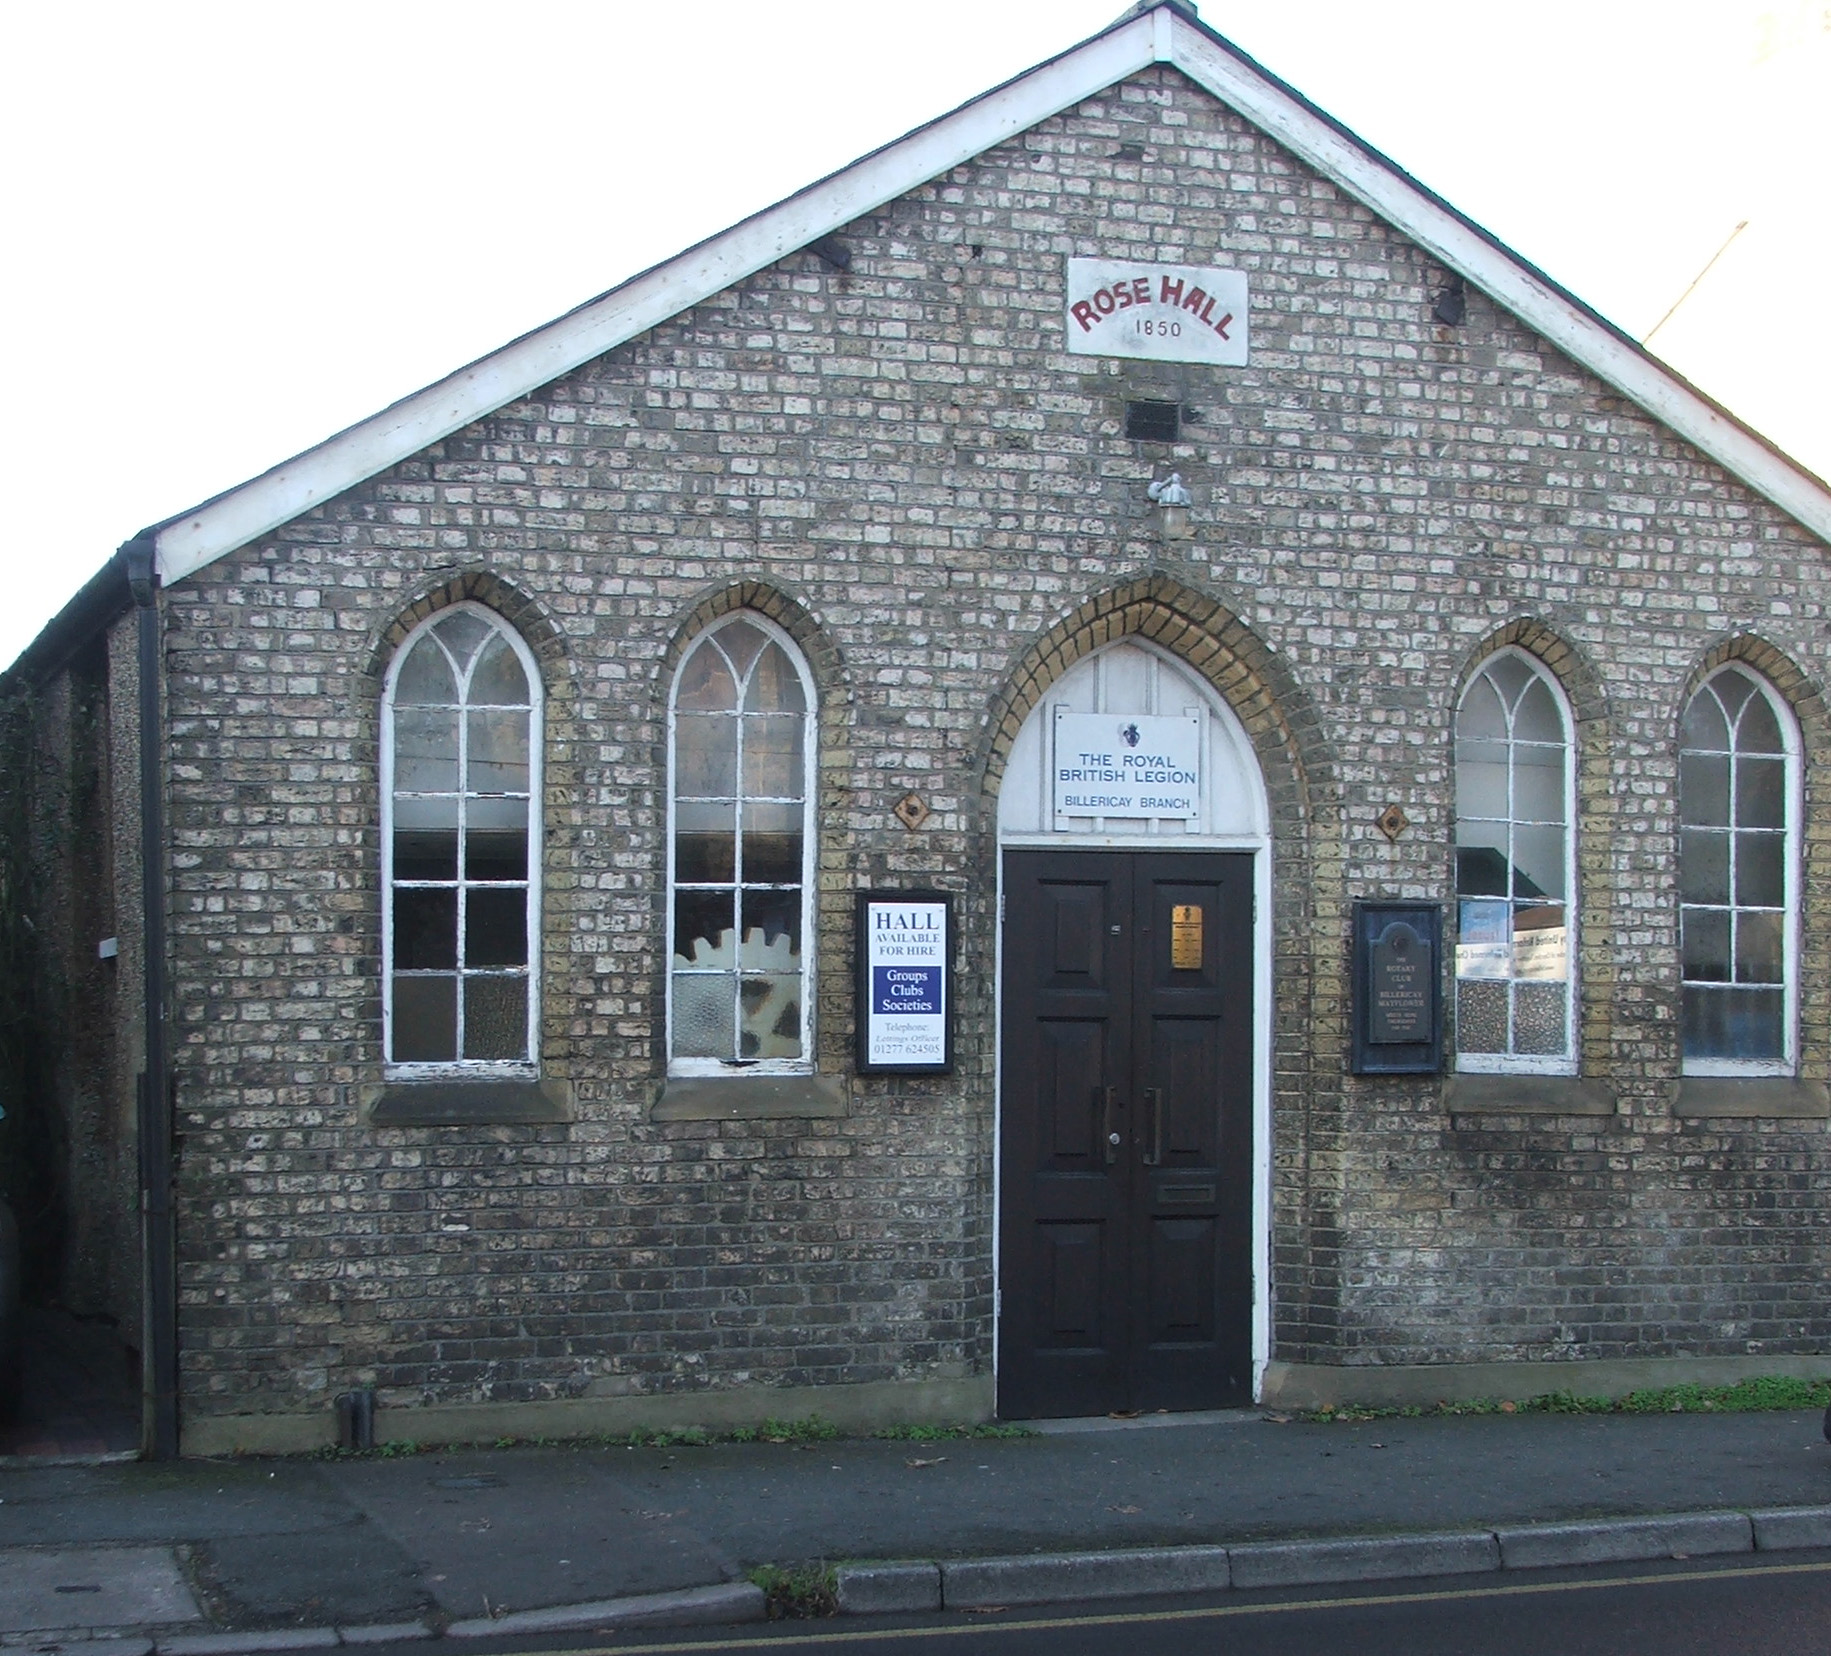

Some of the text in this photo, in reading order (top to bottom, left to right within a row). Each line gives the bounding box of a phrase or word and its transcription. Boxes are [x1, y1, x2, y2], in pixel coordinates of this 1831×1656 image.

[1070, 275, 1233, 341] ROSE HALL
[1136, 319, 1181, 337] 1850
[1079, 753, 1175, 768] THE ROYAL
[1059, 769, 1196, 784] BRITISH LEGION
[1065, 795, 1190, 809] BILLERICAY BRANCH
[876, 912, 939, 929] HALL
[875, 933, 940, 943] AVAILABLE
[880, 946, 936, 956] FOR HIRE
[886, 969, 928, 984] Groups
[1391, 974, 1411, 982] CLUB
[891, 984, 924, 996] Clubs
[882, 998, 932, 1011] Societies
[1378, 999, 1424, 1007] MAYFLOWER
[910, 1034, 940, 1042] Officer
[874, 1044, 903, 1054] 01277
